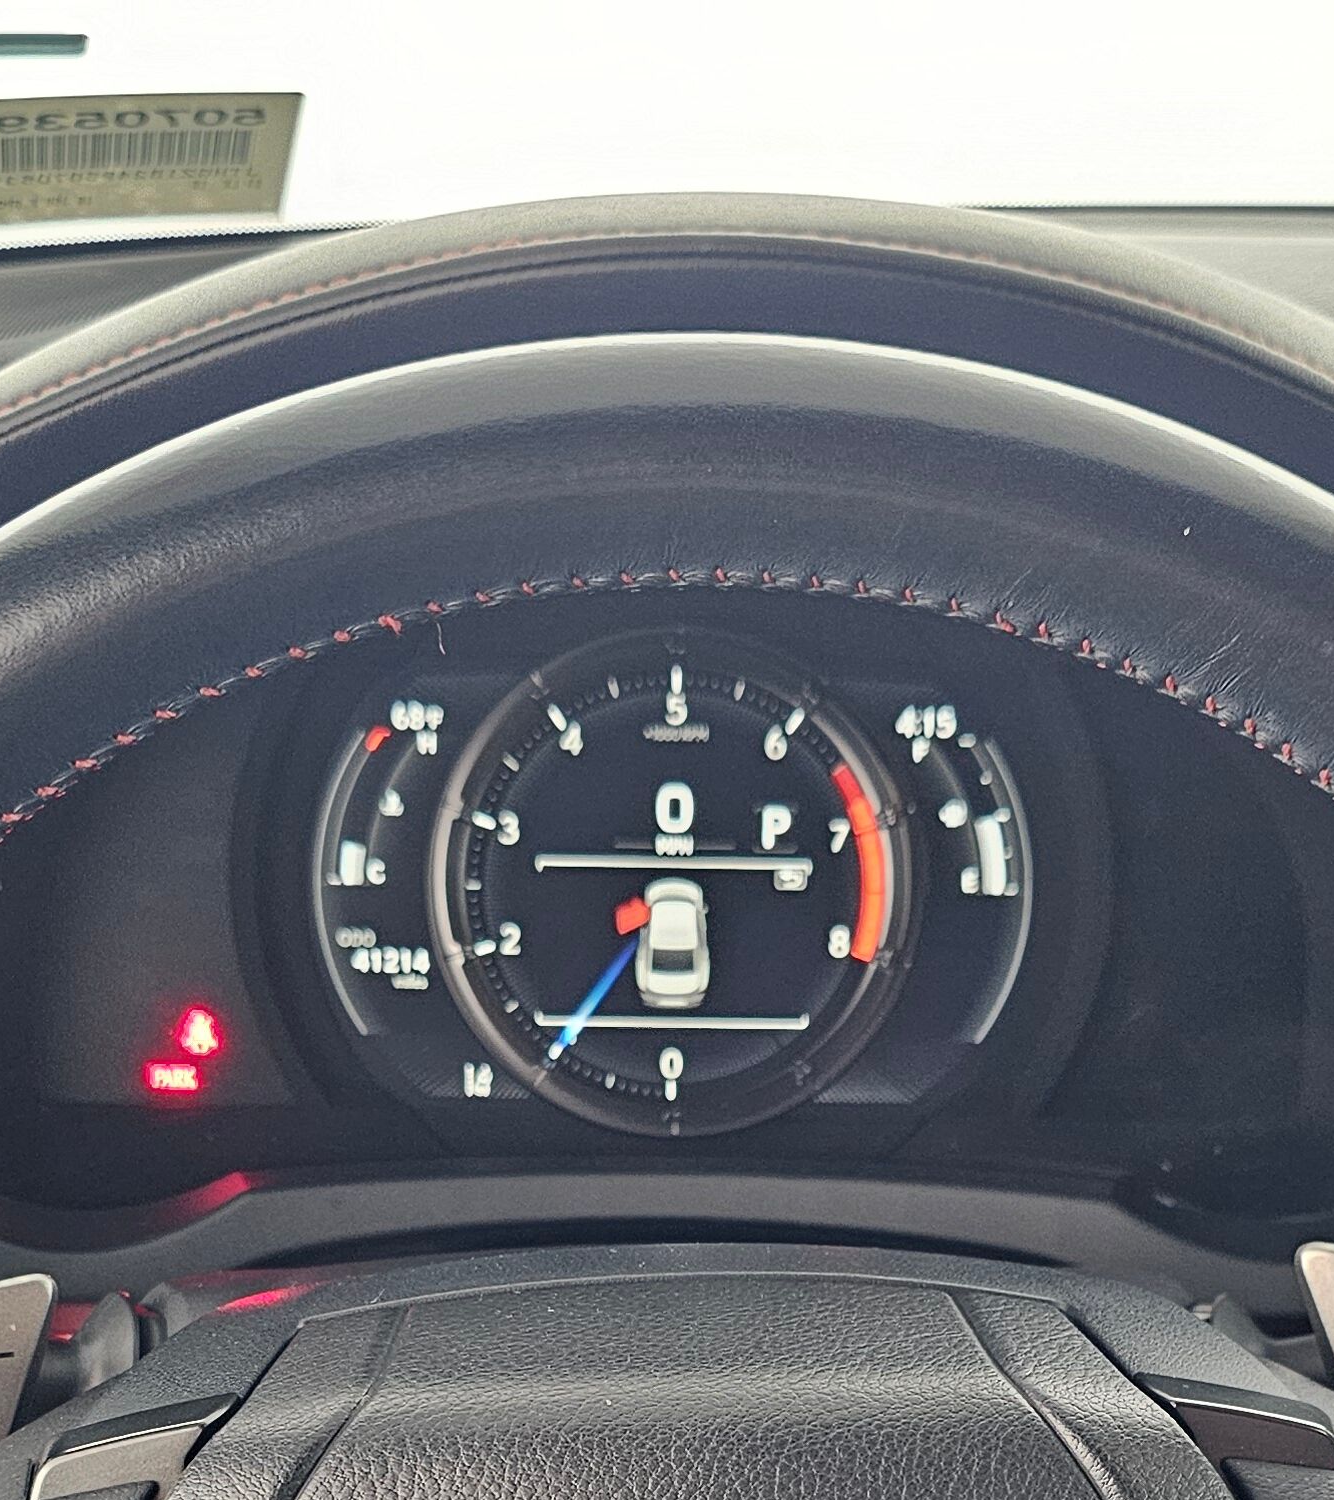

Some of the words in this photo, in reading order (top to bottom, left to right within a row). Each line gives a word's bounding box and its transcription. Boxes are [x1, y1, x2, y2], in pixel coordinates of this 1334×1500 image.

[665, 691, 687, 726] 5
[559, 720, 584, 756] 4
[764, 724, 788, 761] 6
[655, 781, 694, 833] 0
[497, 811, 521, 846] 3
[761, 804, 792, 850] P
[828, 817, 850, 853] 7
[499, 921, 522, 956] 2
[828, 924, 850, 958] 8
[350, 946, 431, 974] 41214
[660, 1047, 683, 1078] 0
